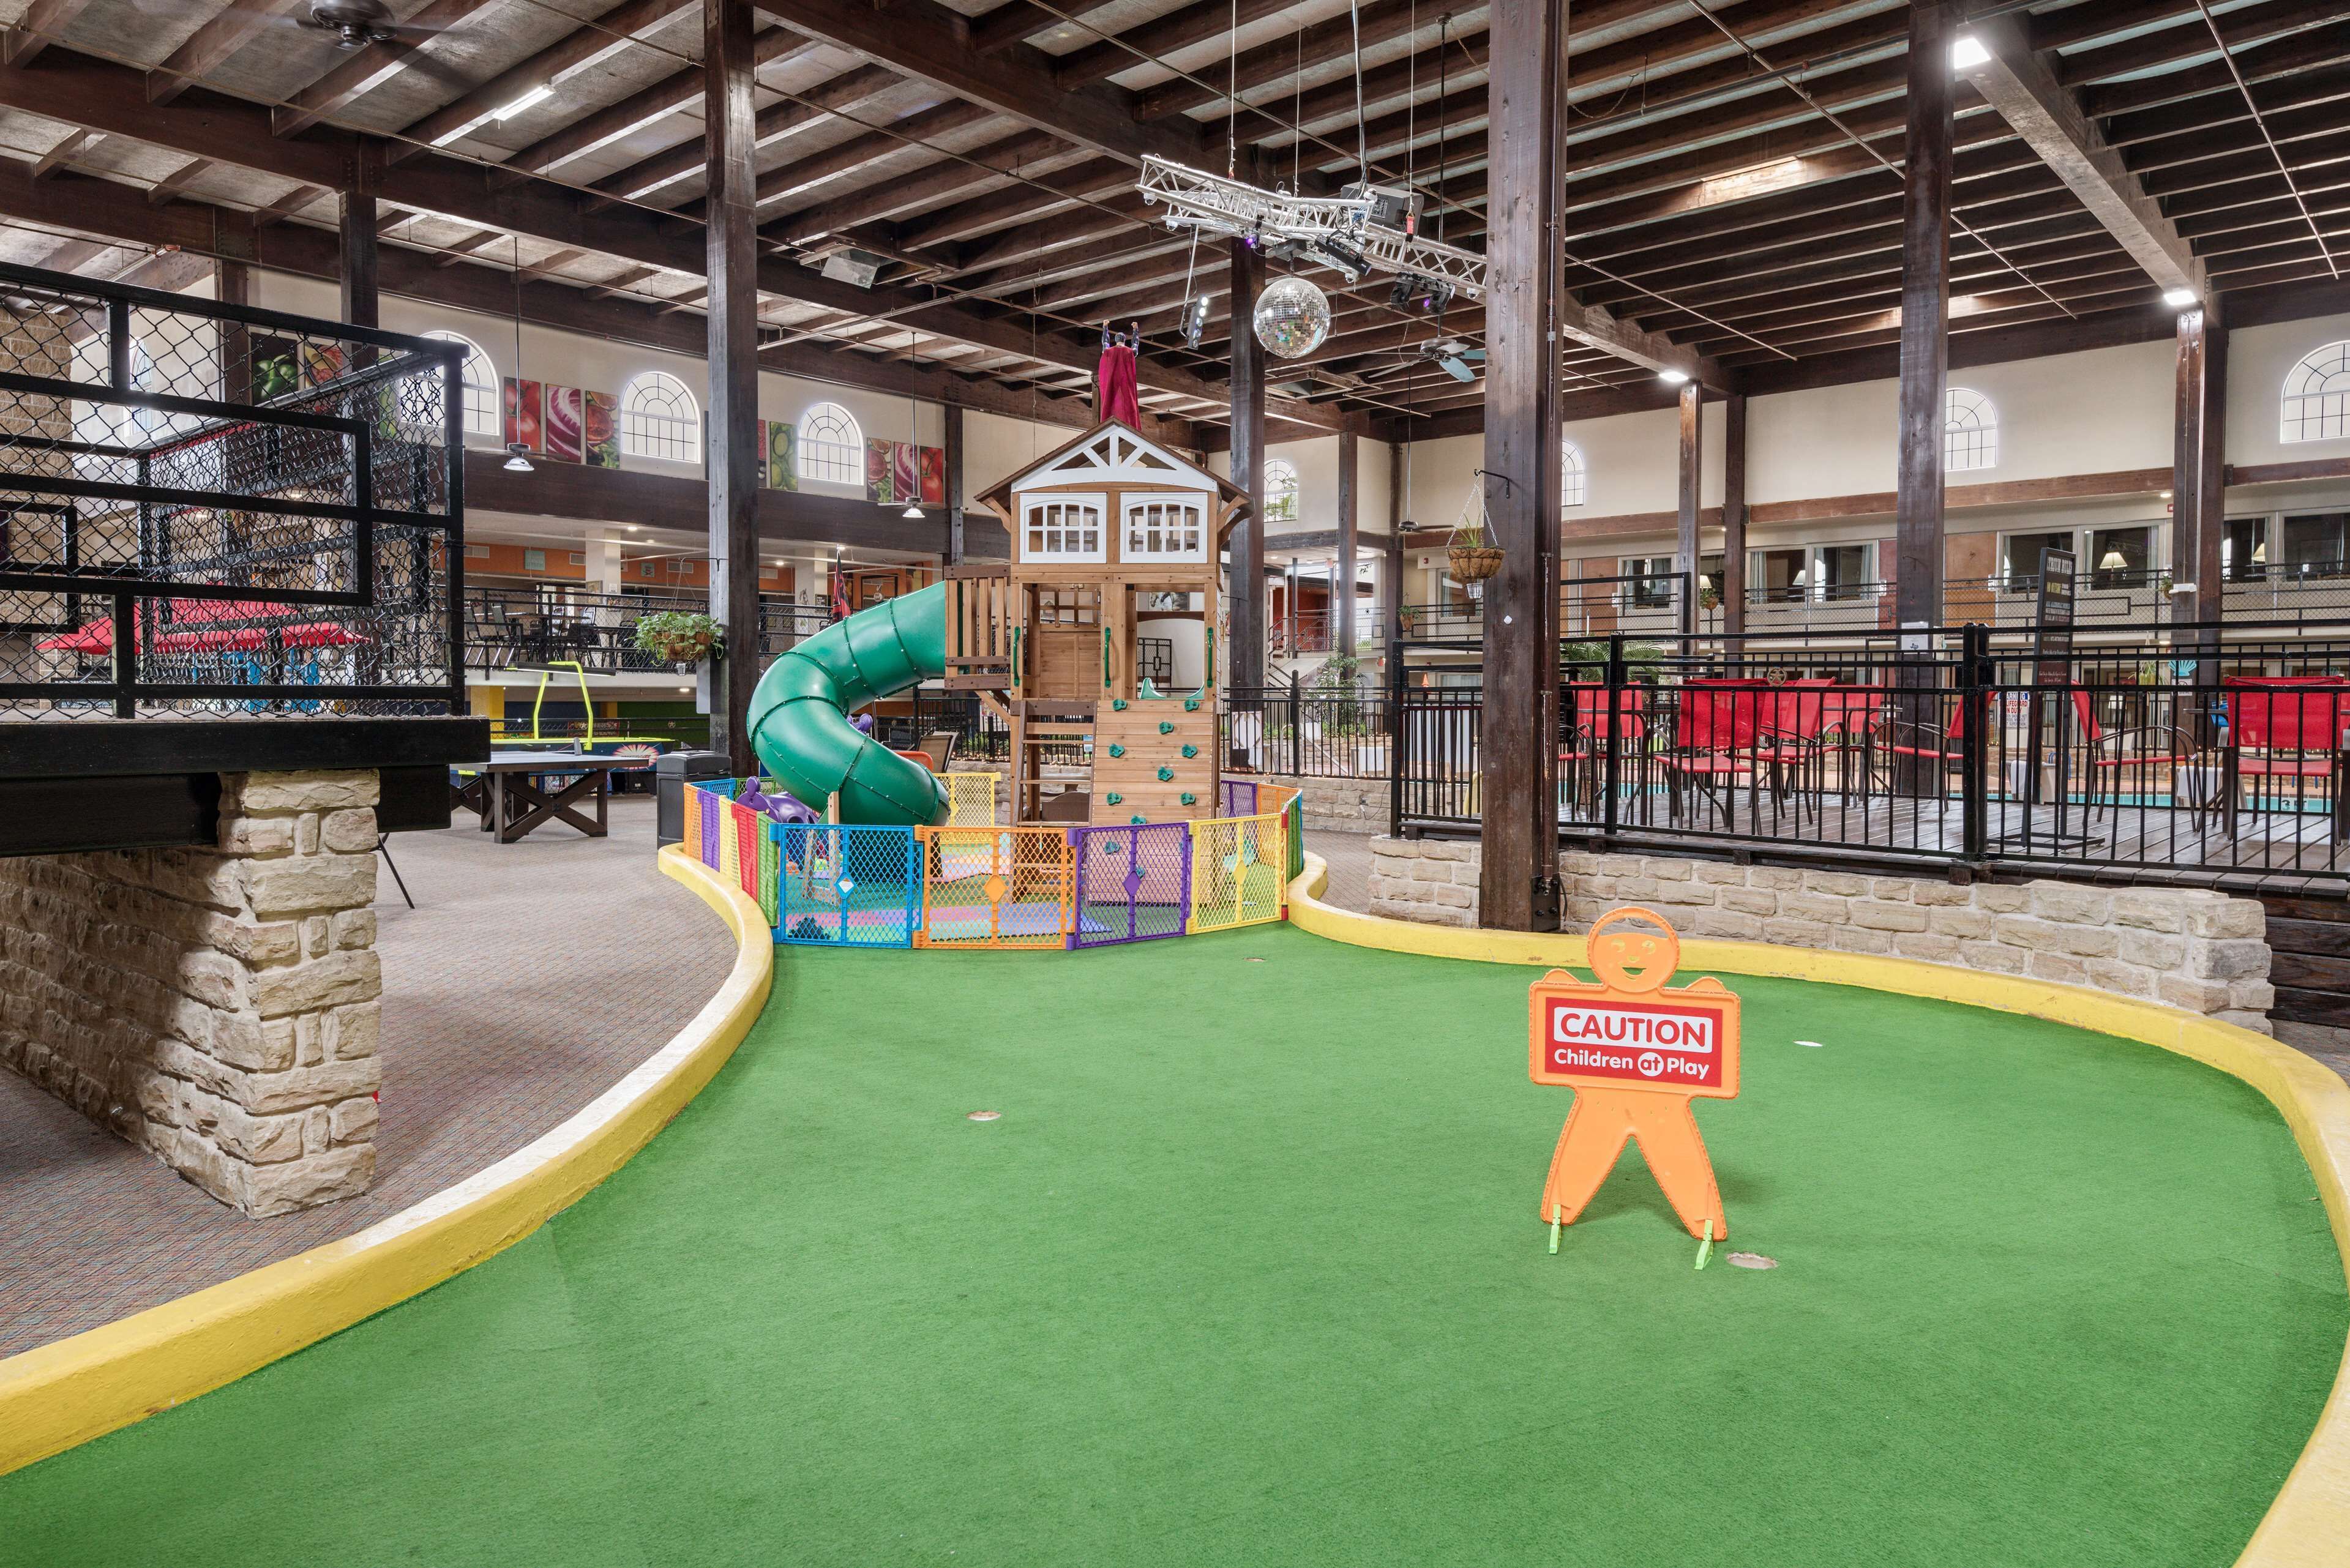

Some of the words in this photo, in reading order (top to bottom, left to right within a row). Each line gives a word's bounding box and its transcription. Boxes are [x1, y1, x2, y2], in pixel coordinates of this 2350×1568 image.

[1560, 1013, 1705, 1047] CAUTION
[1554, 1048, 1633, 1070] Children
[1639, 1055, 1661, 1072] at
[1667, 1057, 1710, 1080] Play
